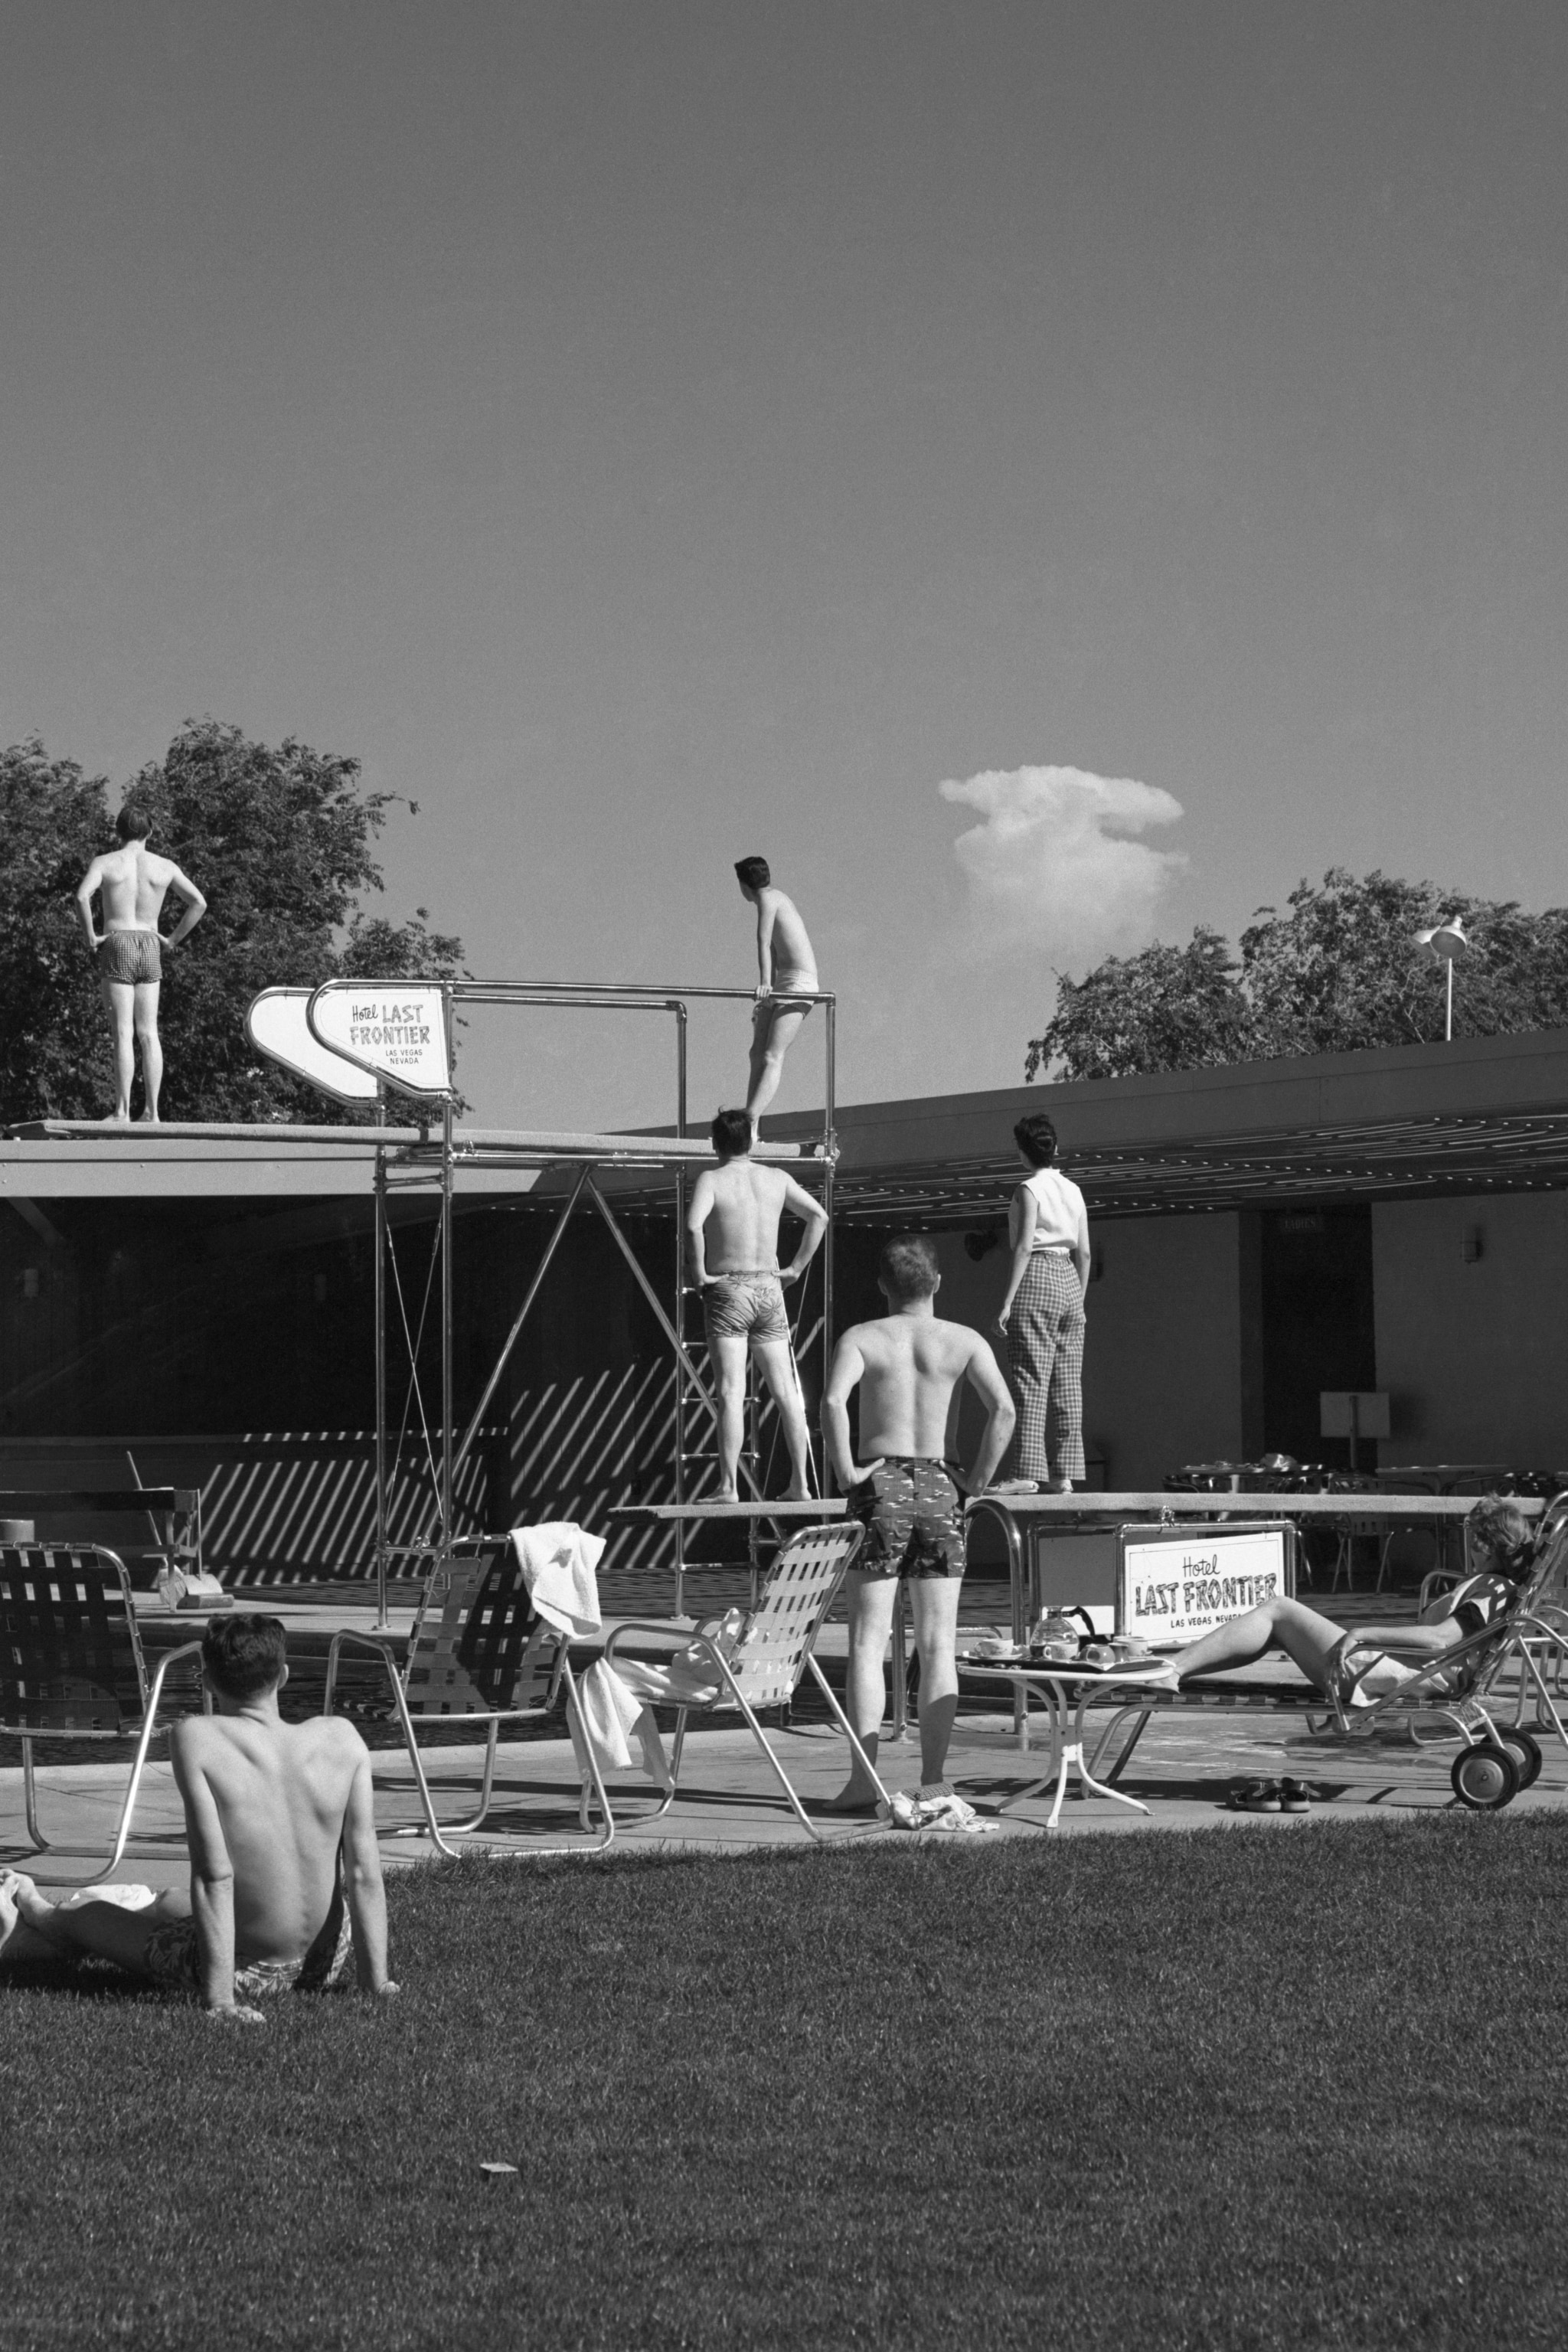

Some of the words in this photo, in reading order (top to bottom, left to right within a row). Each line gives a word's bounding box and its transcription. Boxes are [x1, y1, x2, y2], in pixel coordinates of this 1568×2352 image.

[352, 1004, 379, 1022] Hotel
[382, 1004, 423, 1023] LAST
[349, 1026, 430, 1046] FRONTIER
[1285, 1217, 1316, 1230] LADIES
[1182, 1553, 1221, 1577] Hotel
[1135, 1582, 1179, 1617] LAST
[1183, 1573, 1277, 1613] FRONTIER
[1171, 1619, 1184, 1628] LAS
[1187, 1616, 1212, 1626] VEGAS
